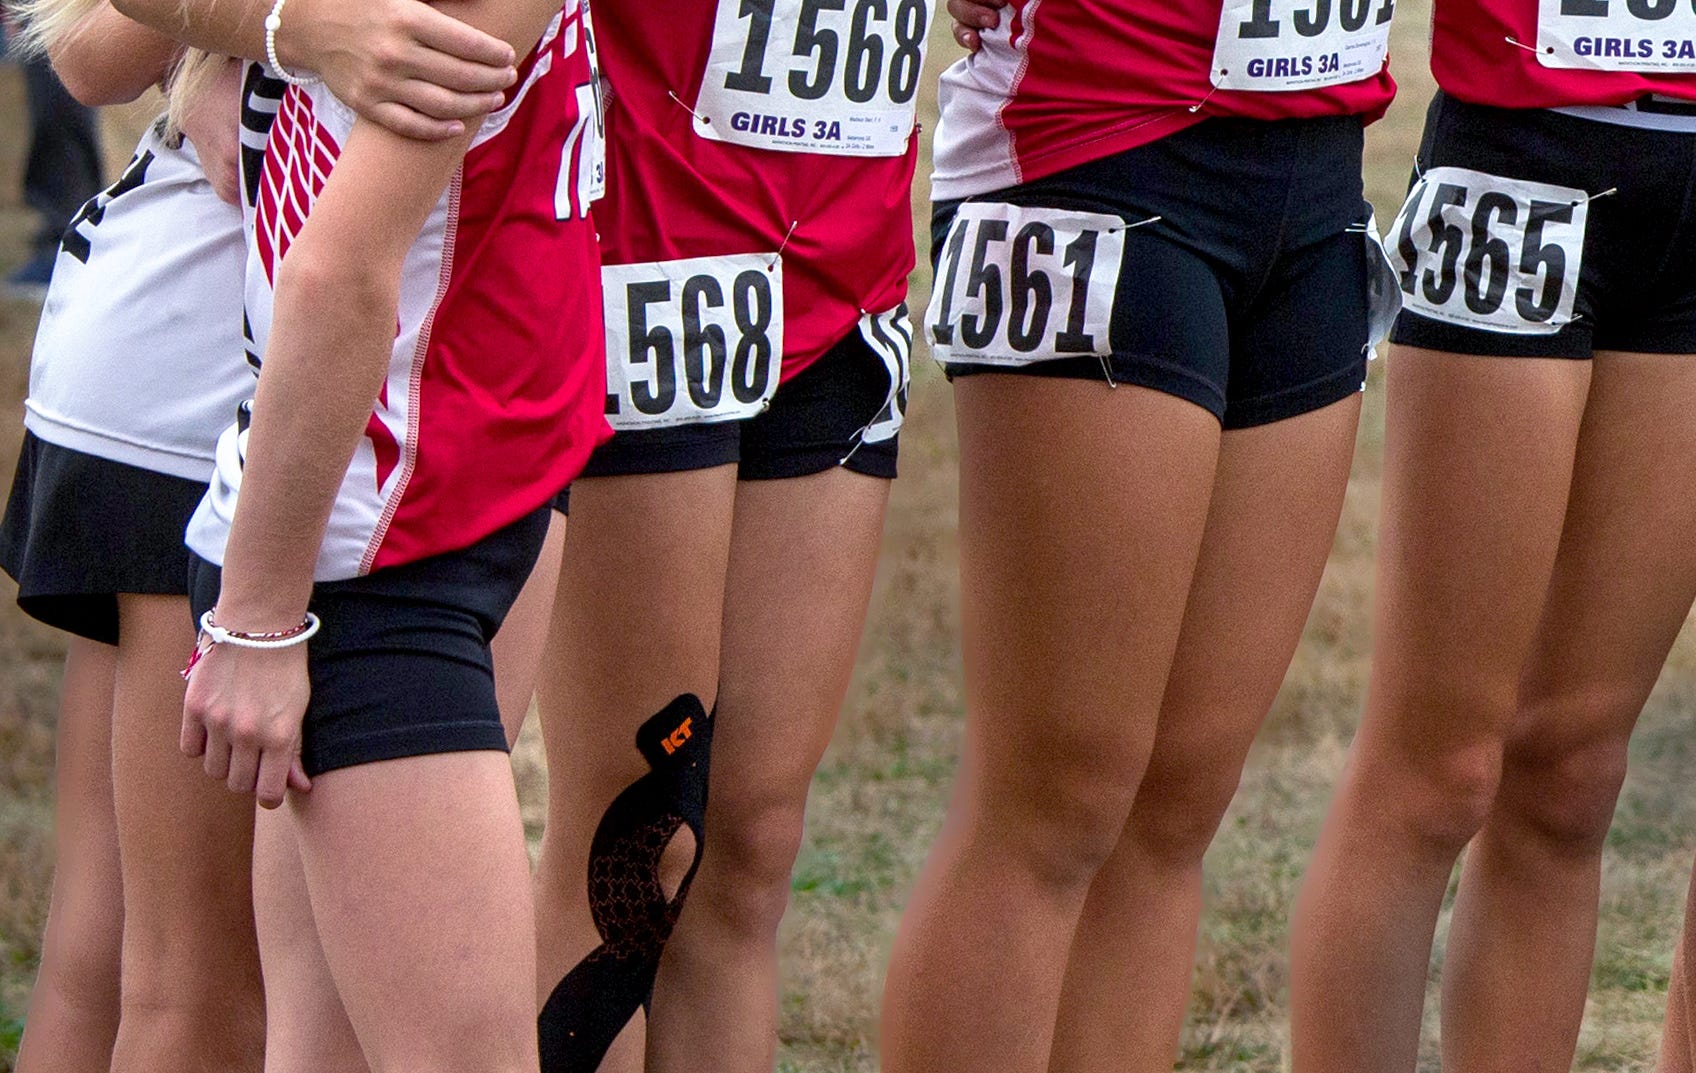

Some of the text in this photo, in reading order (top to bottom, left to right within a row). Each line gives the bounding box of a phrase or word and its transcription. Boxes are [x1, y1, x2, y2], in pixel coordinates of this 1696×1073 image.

[1573, 36, 1653, 58] GIRLS
[1662, 40, 1696, 59] 3A
[1247, 56, 1313, 77] GIRLS
[1317, 53, 1339, 73] 3A
[730, 111, 806, 138] GIRLS
[813, 120, 841, 140] 3A
[1398, 181, 1574, 323] 1565
[931, 219, 1098, 354] 1561
